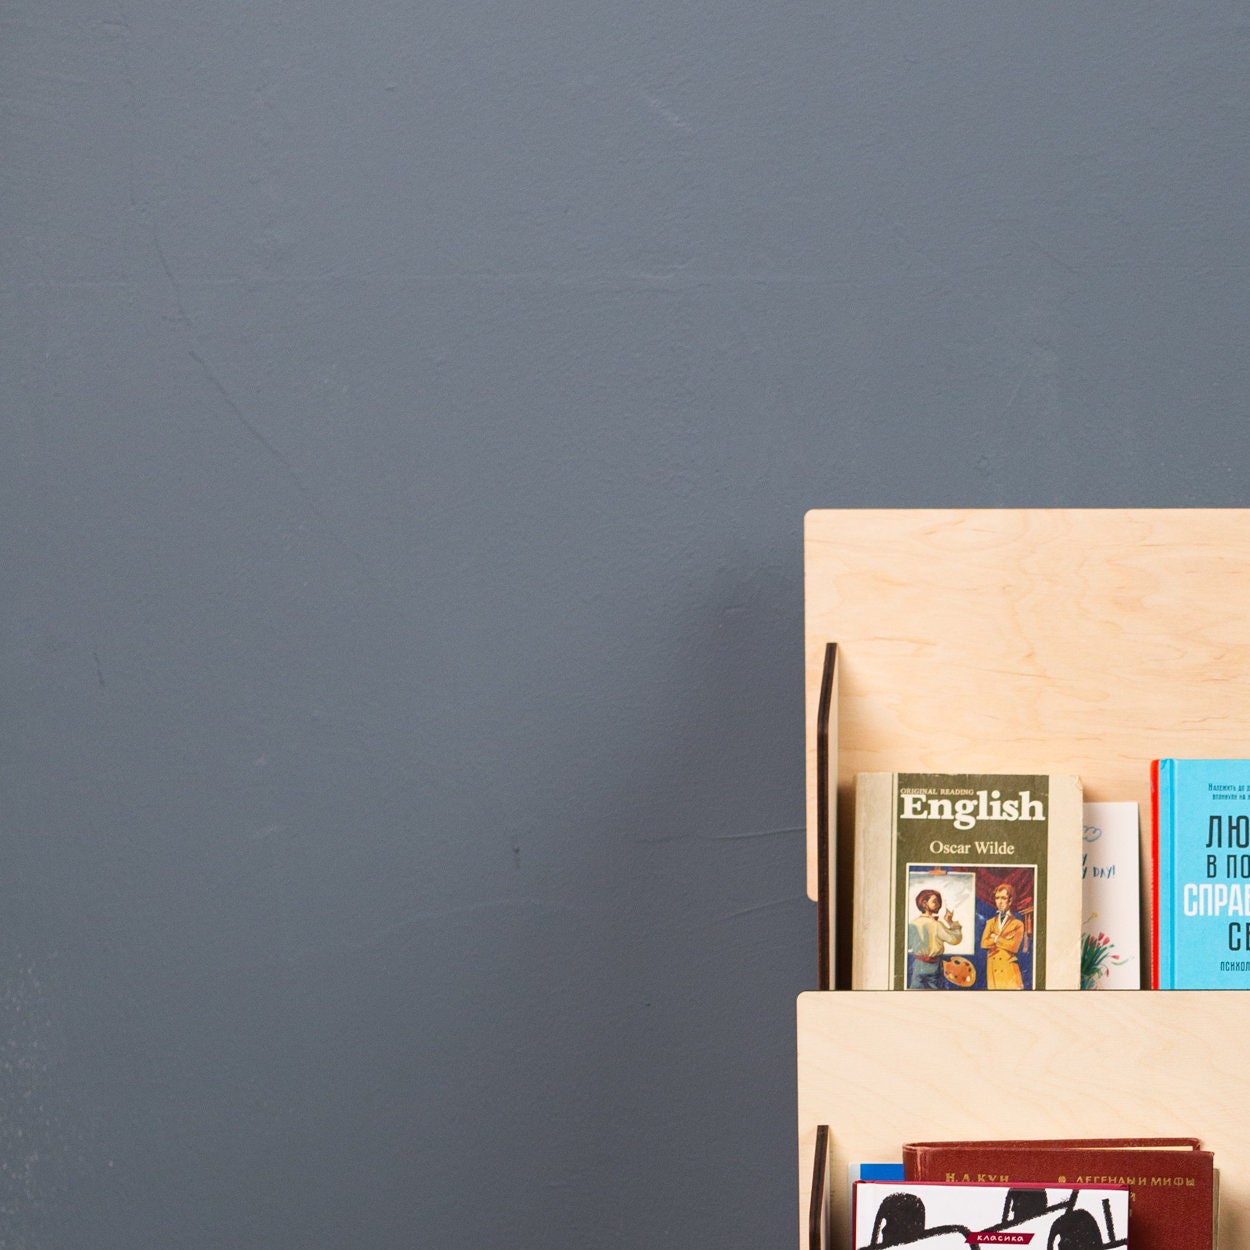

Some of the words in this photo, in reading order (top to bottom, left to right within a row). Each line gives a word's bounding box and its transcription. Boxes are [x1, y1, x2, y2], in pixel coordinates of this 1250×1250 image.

[900, 790, 1046, 830] English
[930, 840, 971, 854] Oscar
[975, 841, 1014, 855] Wilde
[1207, 855, 1217, 878] В
